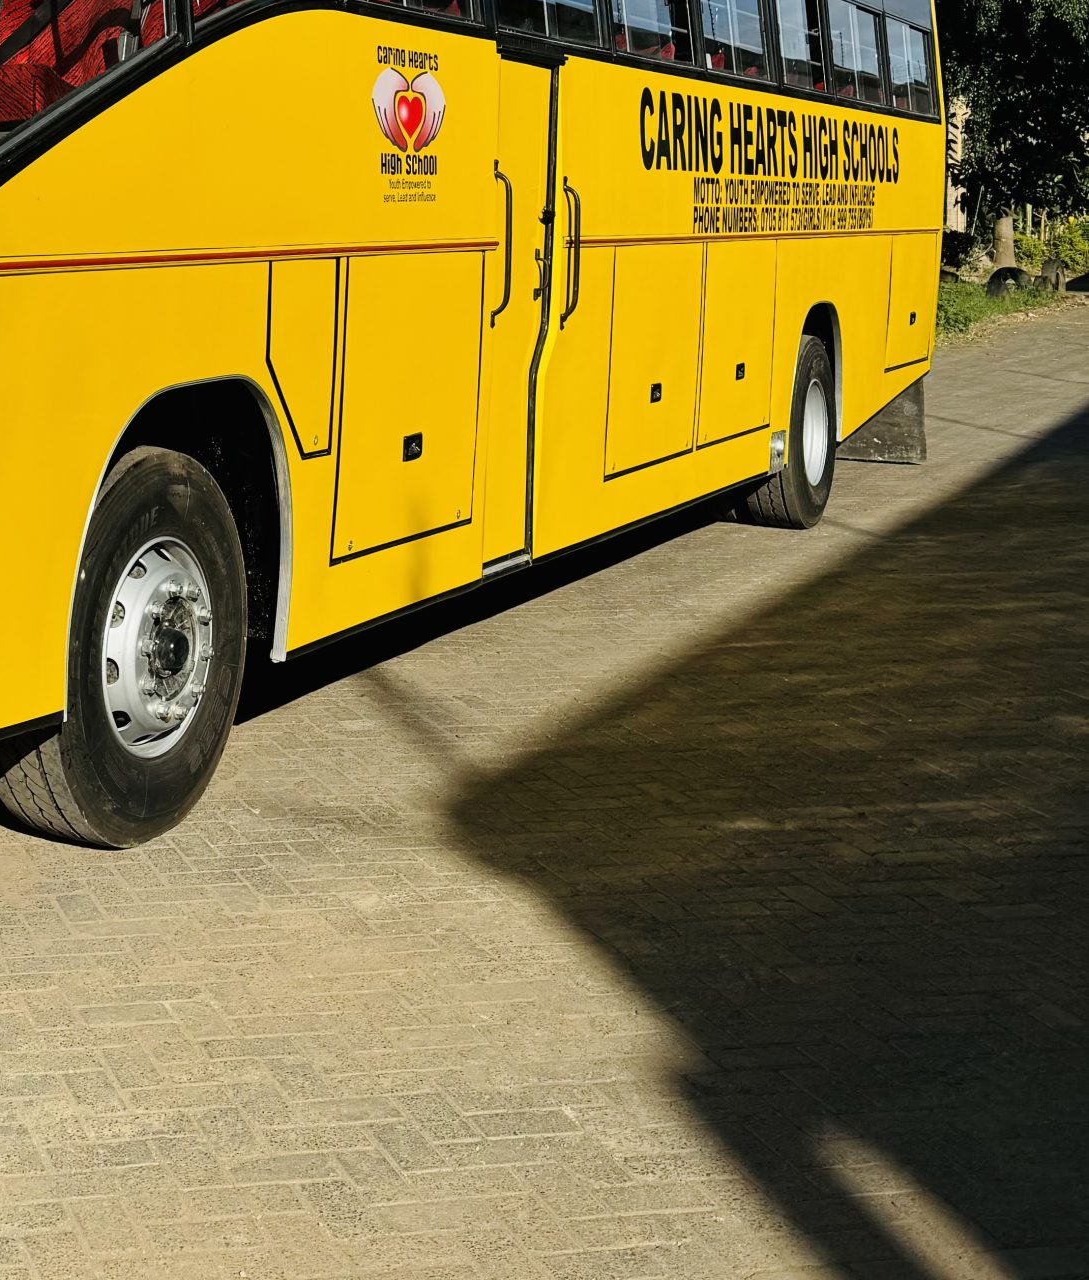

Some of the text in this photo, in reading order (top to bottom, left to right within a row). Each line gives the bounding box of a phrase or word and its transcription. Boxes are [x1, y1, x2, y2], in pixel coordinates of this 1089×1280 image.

[639, 87, 899, 184] CARING HEARTS HIGH SCHOOLS
[381, 153, 402, 175] High
[693, 177, 722, 204] MOTTO:
[725, 178, 748, 205] YOUTH
[750, 180, 790, 205] EMPOWERED
[792, 182, 800, 206] TO
[822, 183, 836, 206] LEAD
[837, 184, 848, 206] AND
[849, 184, 876, 206] INFLUENCE
[693, 206, 720, 233] PHONE
[722, 207, 759, 232] NUMBERS:
[761, 207, 776, 231] 0705
[778, 208, 789, 231] 811
[823, 208, 836, 230] 0114
